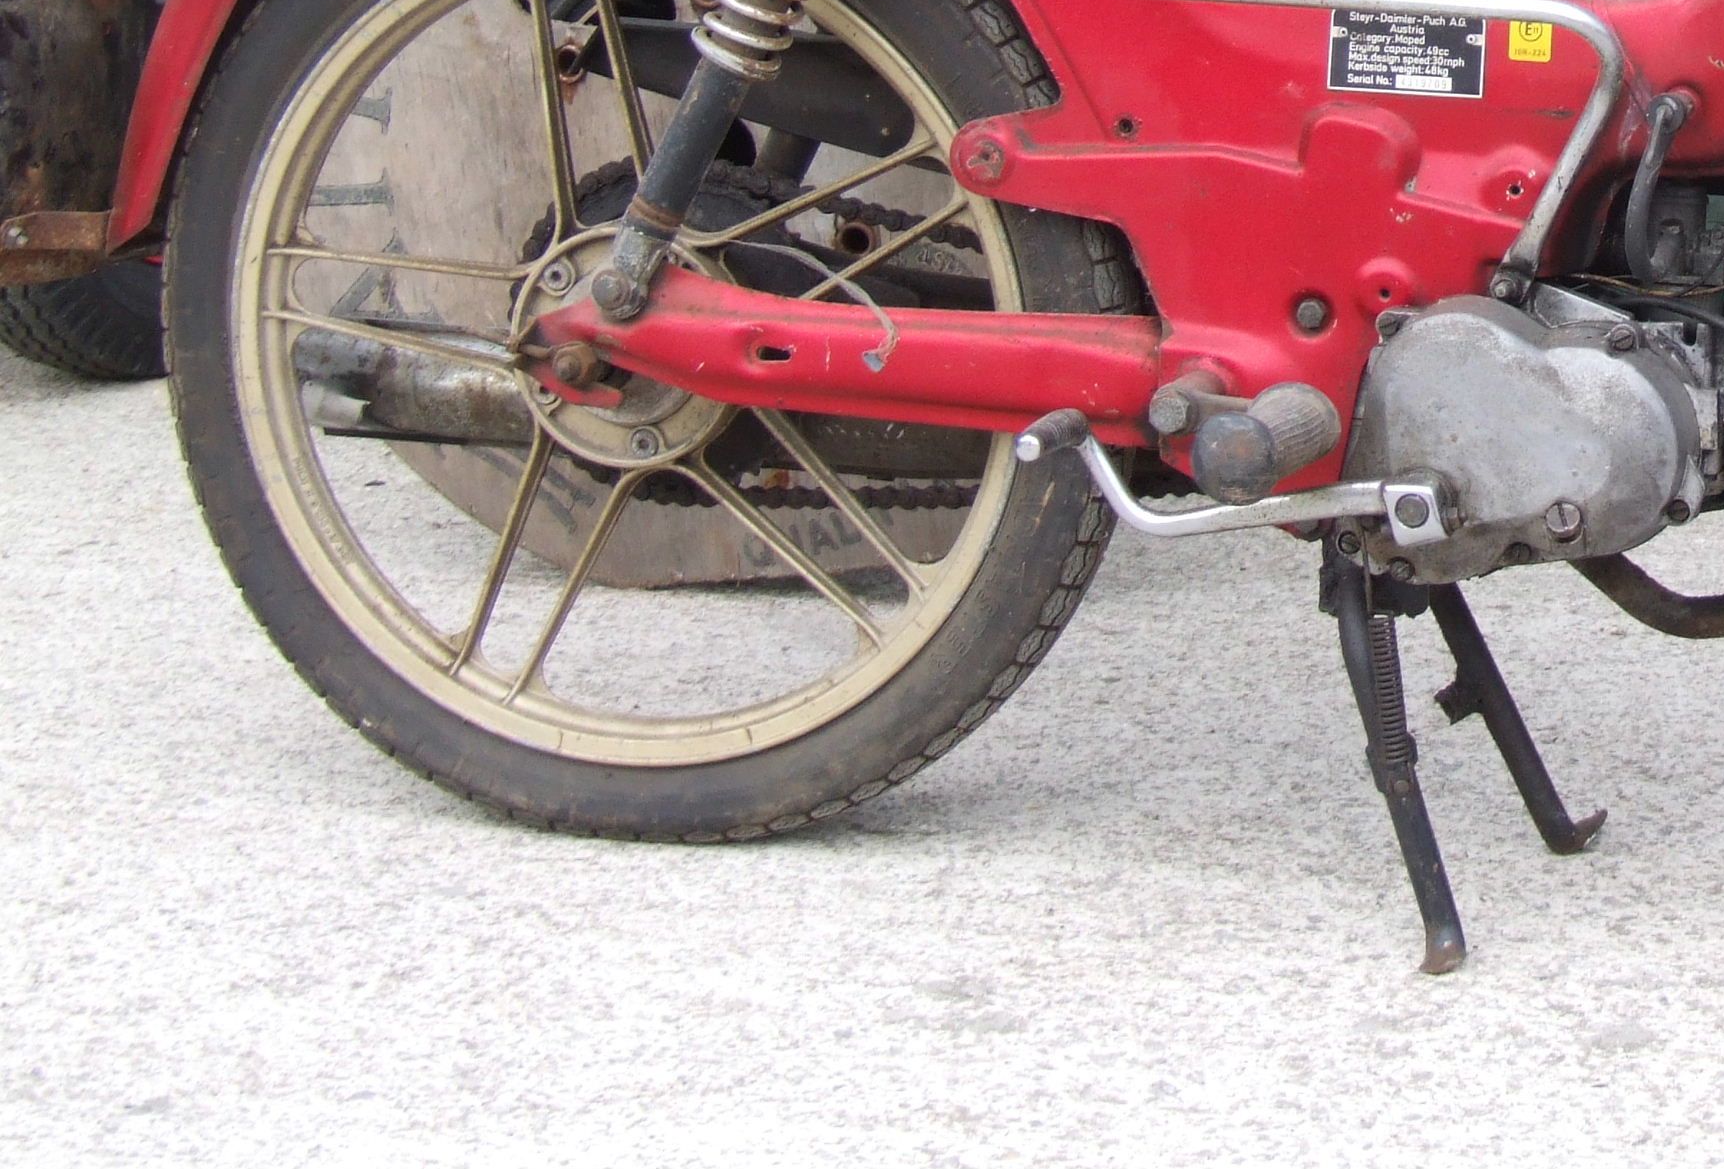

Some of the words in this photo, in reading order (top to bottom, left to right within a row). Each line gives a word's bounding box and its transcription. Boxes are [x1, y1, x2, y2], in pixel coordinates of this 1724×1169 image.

[1390, 23, 1425, 35] Austria
[1349, 42, 1380, 54] Engine
[1348, 60, 1388, 72] Kerbside
[1347, 73, 1374, 84] Serial
